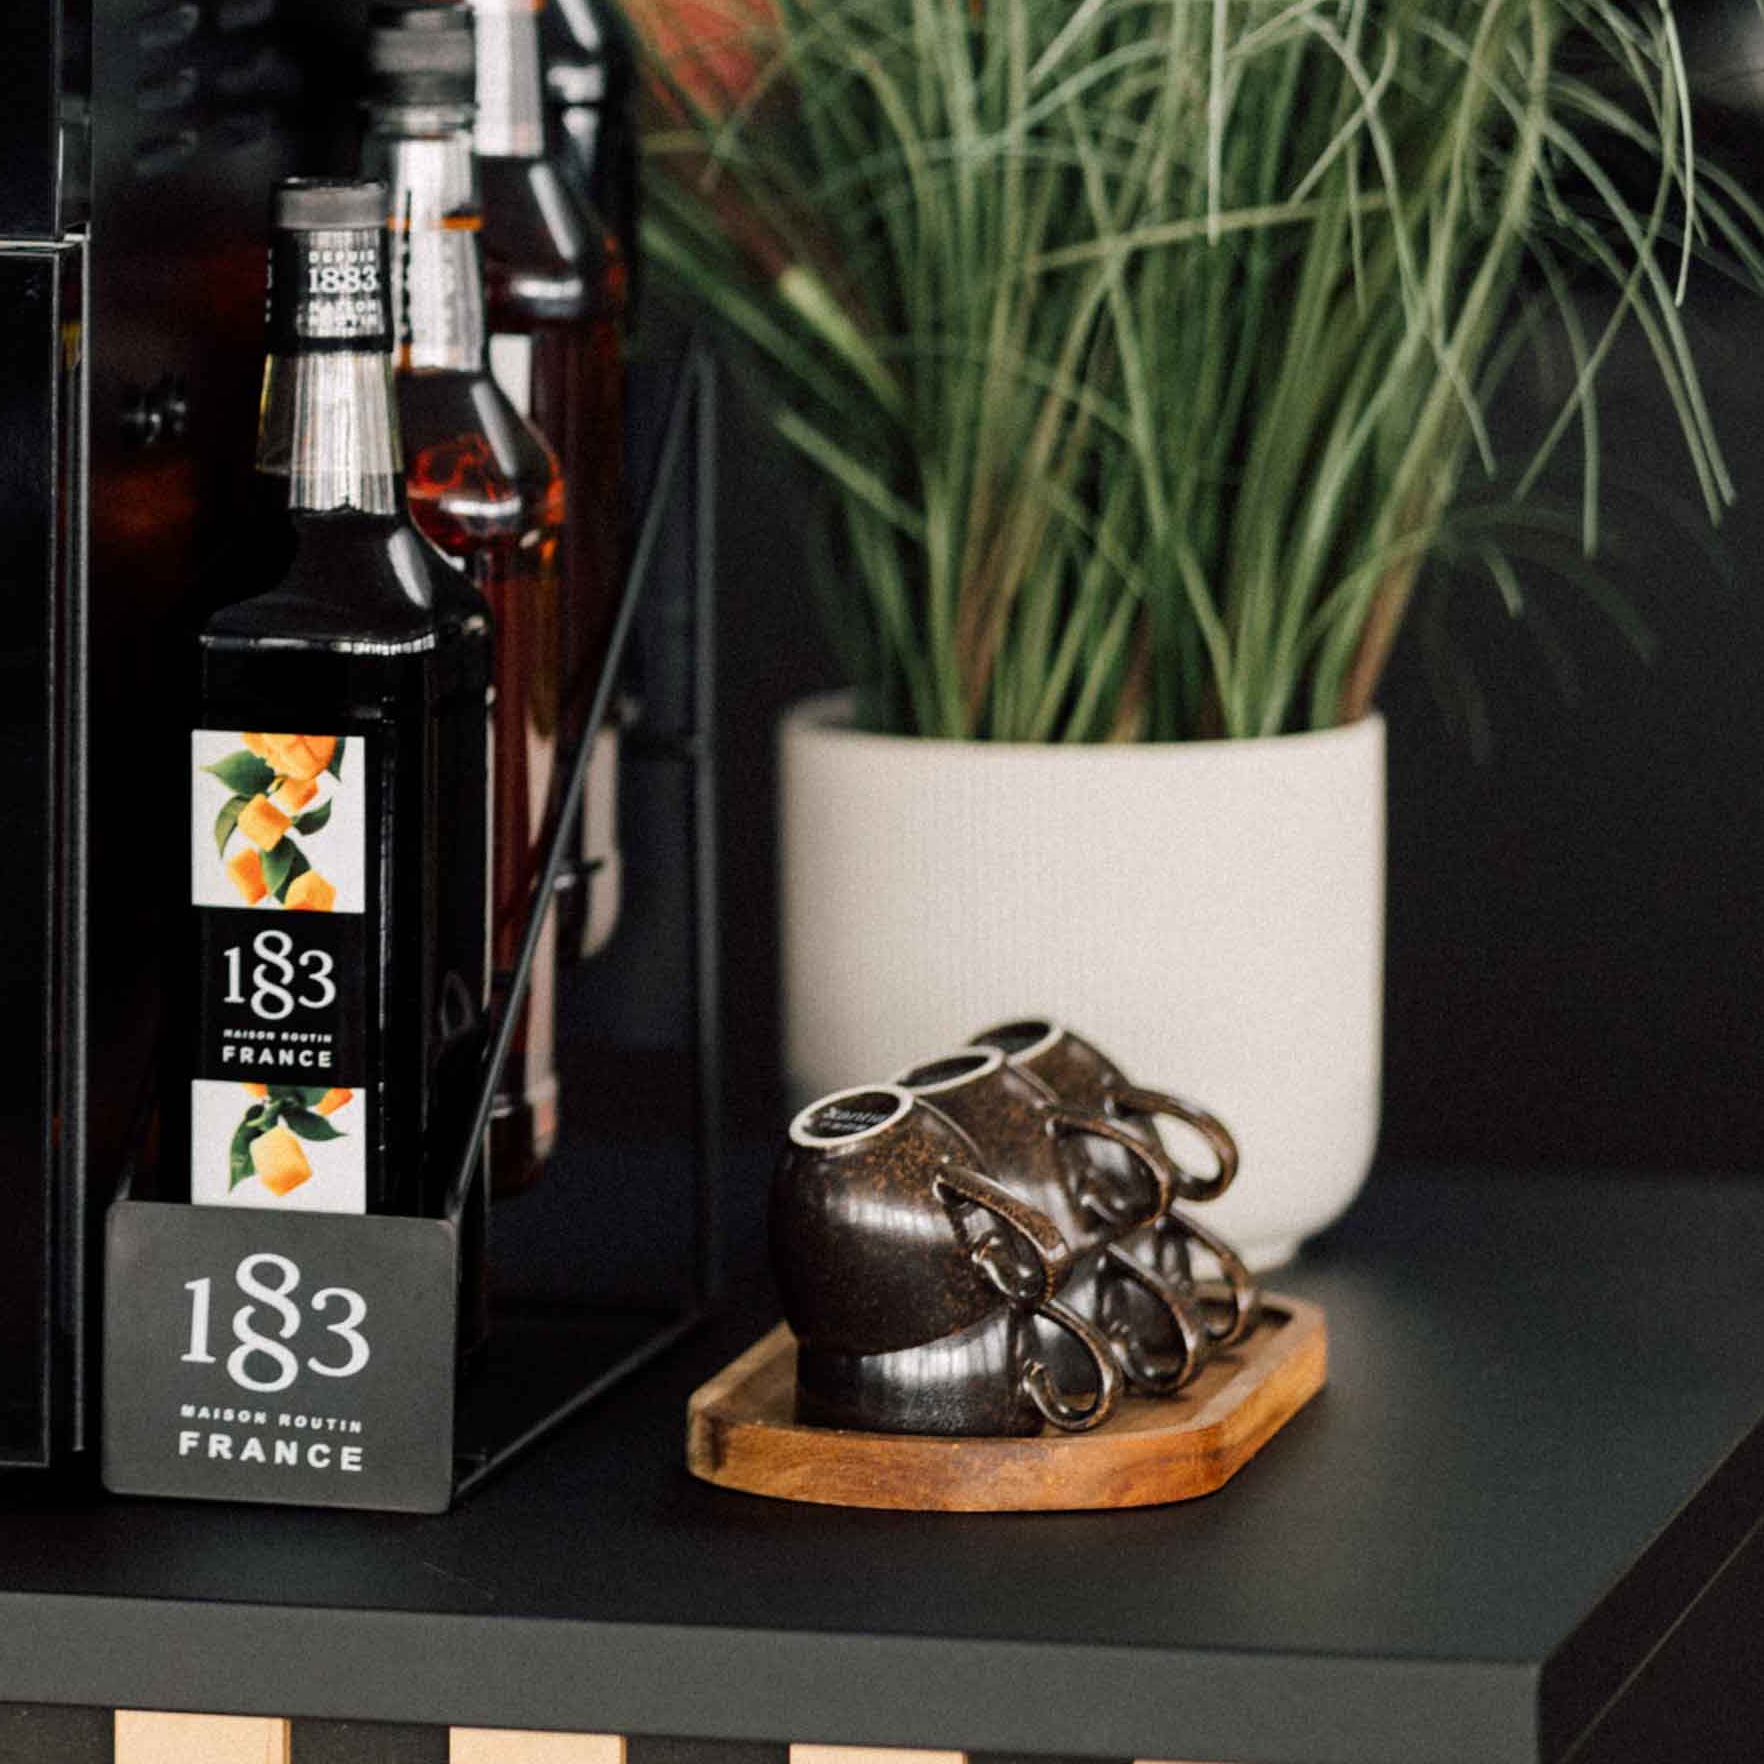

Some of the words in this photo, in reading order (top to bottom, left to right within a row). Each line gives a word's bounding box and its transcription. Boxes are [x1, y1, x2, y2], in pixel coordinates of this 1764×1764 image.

[309, 265, 378, 294] 1883
[223, 1029, 276, 1040] MAISON
[281, 1032, 333, 1043] ROUTIN
[222, 1045, 333, 1068] FRANCE
[180, 1404, 267, 1424] MAISON
[278, 1413, 362, 1434] ROUTIN
[178, 1430, 363, 1472] FRANCE
